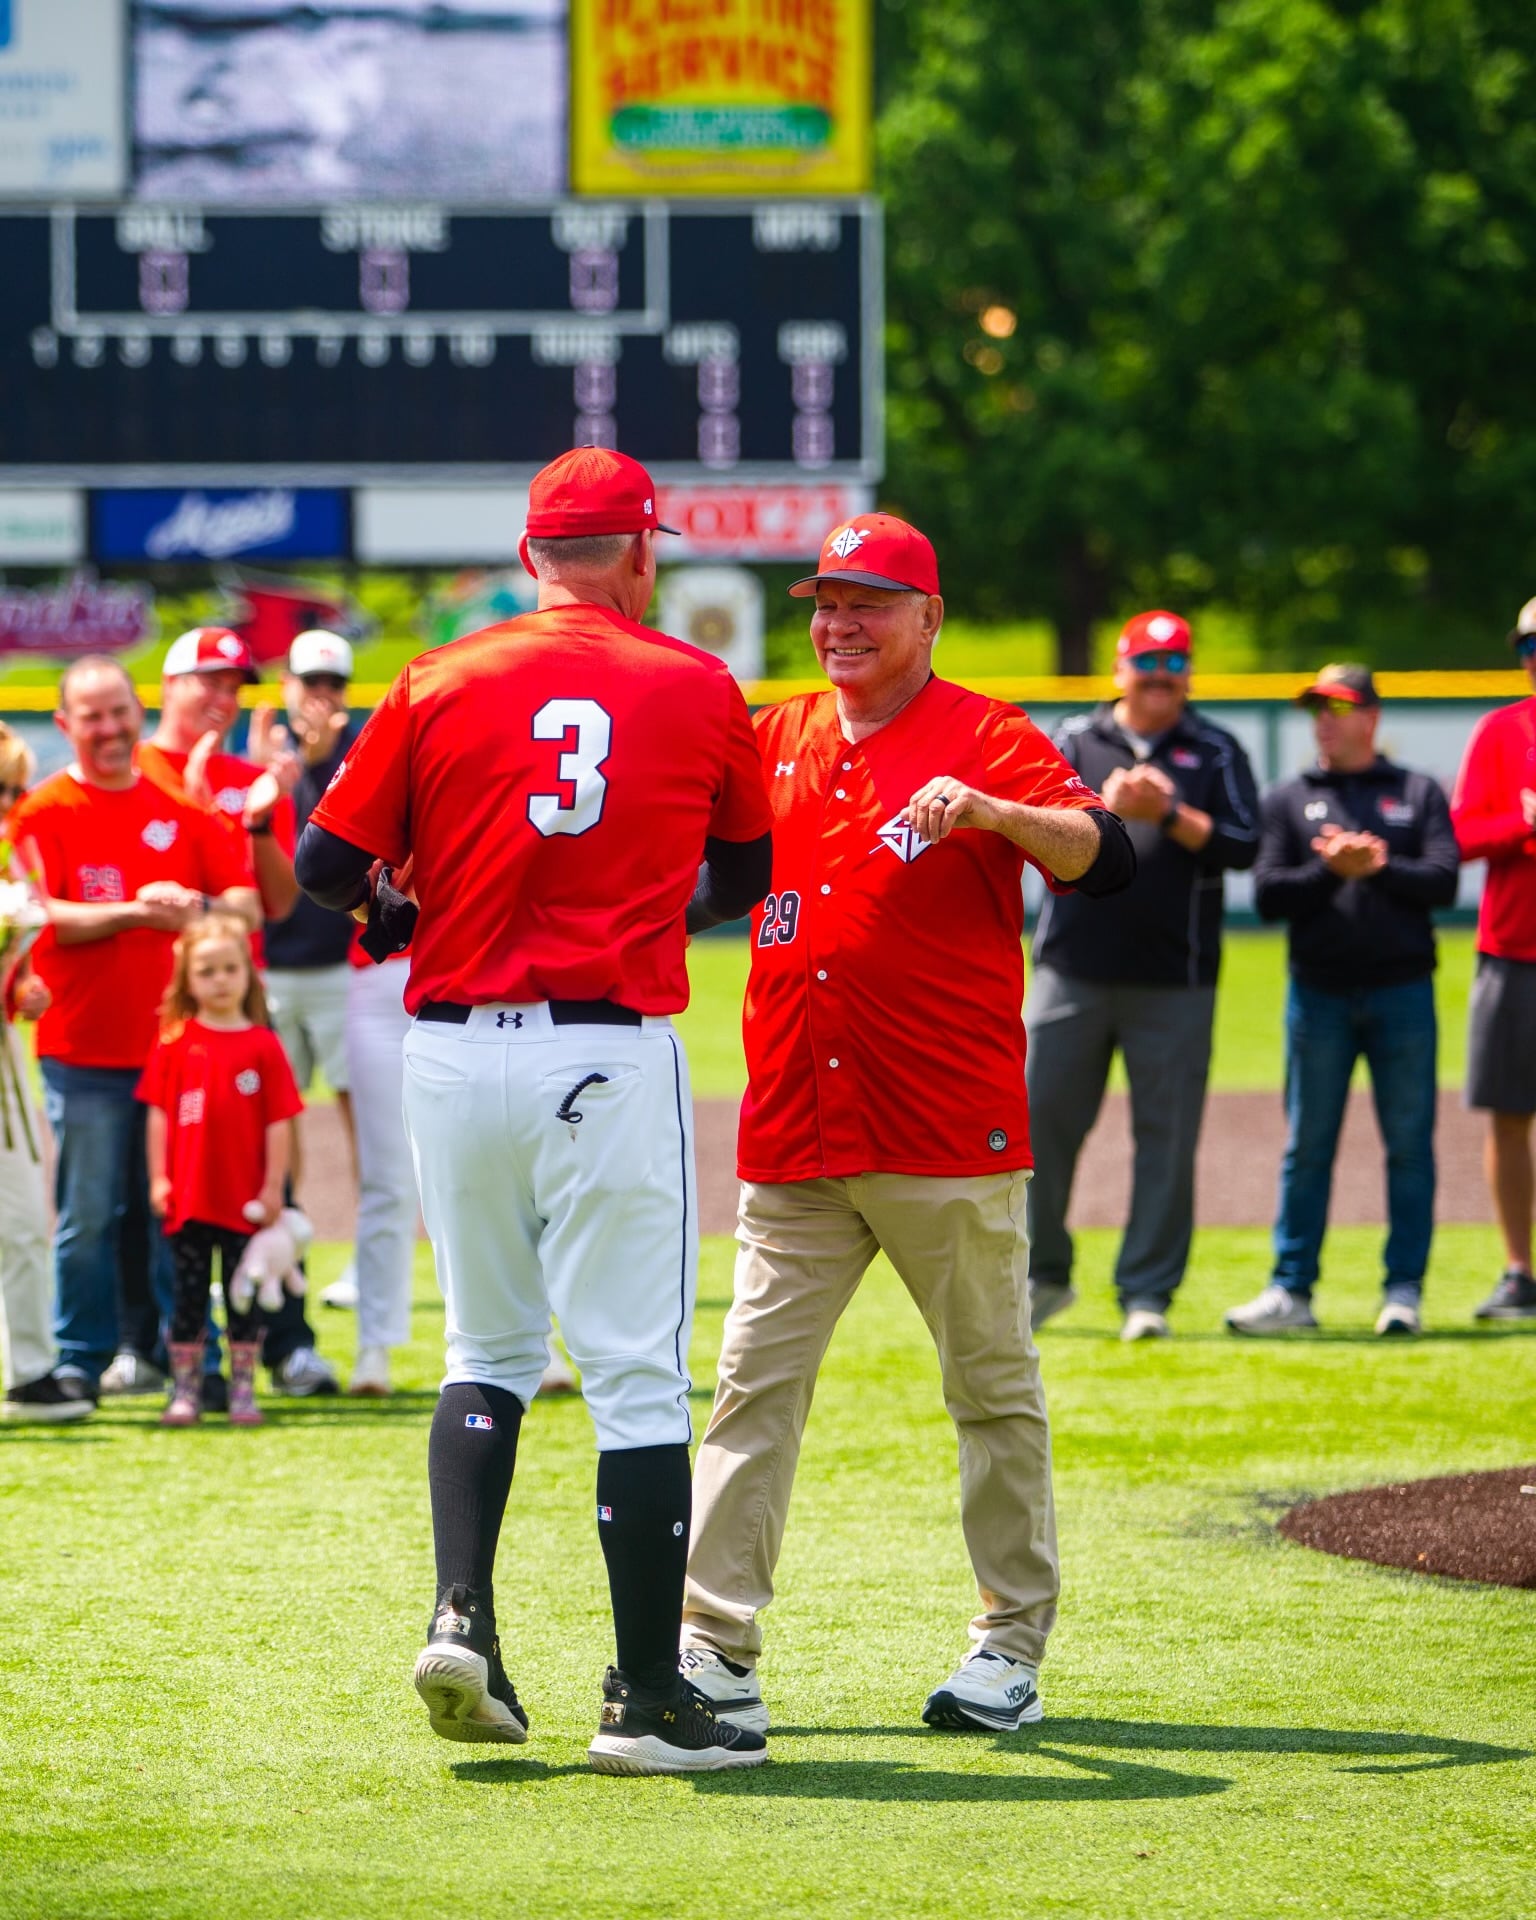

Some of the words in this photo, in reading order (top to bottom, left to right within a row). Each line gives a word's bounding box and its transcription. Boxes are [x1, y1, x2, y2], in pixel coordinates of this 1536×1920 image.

[527, 698, 613, 838] 3
[758, 891, 801, 947] 29
[1004, 1680, 1031, 1706] HOKA
